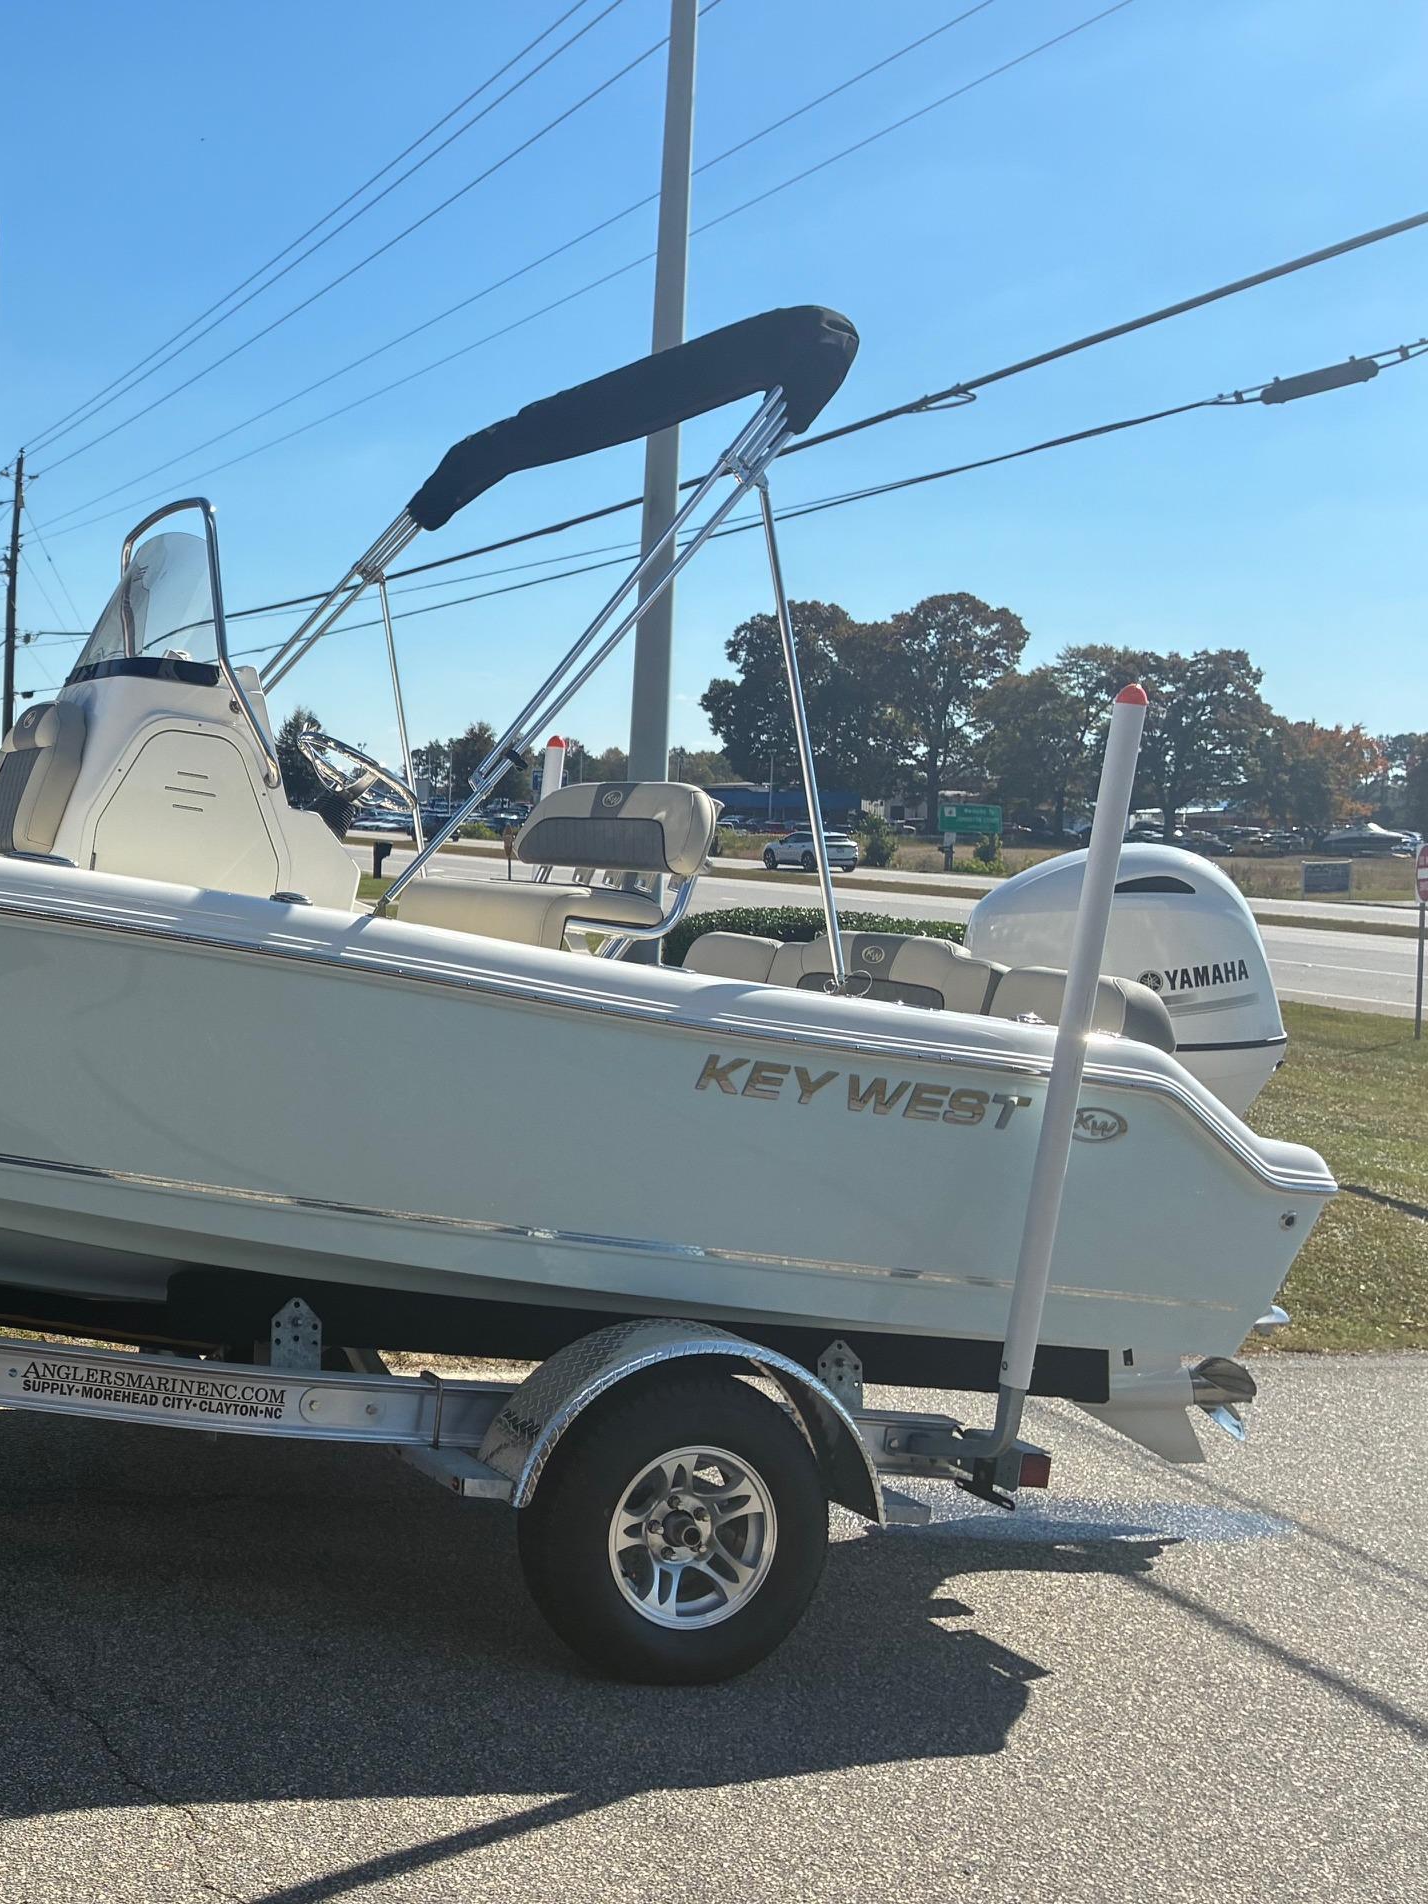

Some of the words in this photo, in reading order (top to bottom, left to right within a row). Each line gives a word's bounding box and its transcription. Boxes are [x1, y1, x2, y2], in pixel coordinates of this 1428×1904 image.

[1164, 959, 1249, 990] YAMAHA
[695, 1054, 839, 1104] KEY
[847, 1073, 1032, 1130] WEST
[21, 1361, 287, 1405] ANGLERSMARINENC.COM
